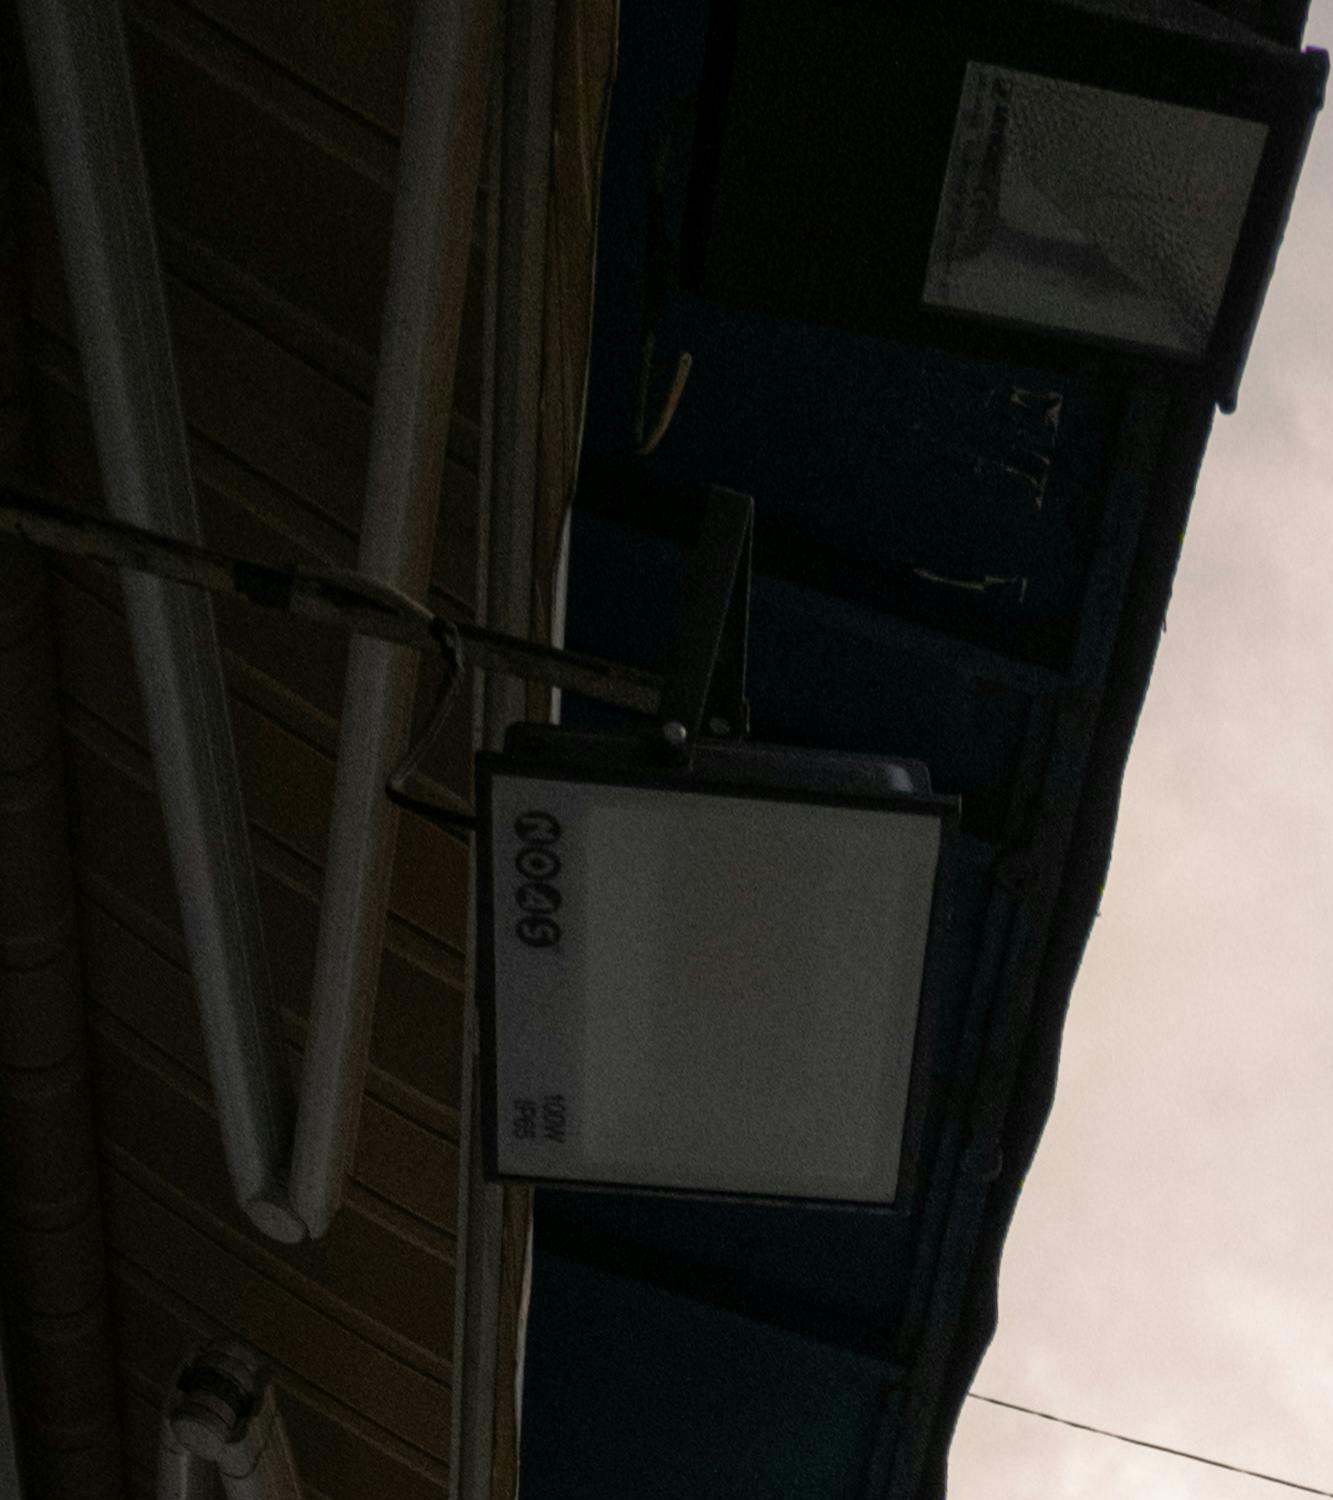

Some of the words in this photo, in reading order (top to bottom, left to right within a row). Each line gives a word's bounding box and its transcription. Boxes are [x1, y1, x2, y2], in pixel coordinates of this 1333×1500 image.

[515, 811, 562, 947] NOAS
[512, 1099, 536, 1139] IP65
[543, 1094, 566, 1144] 100W
